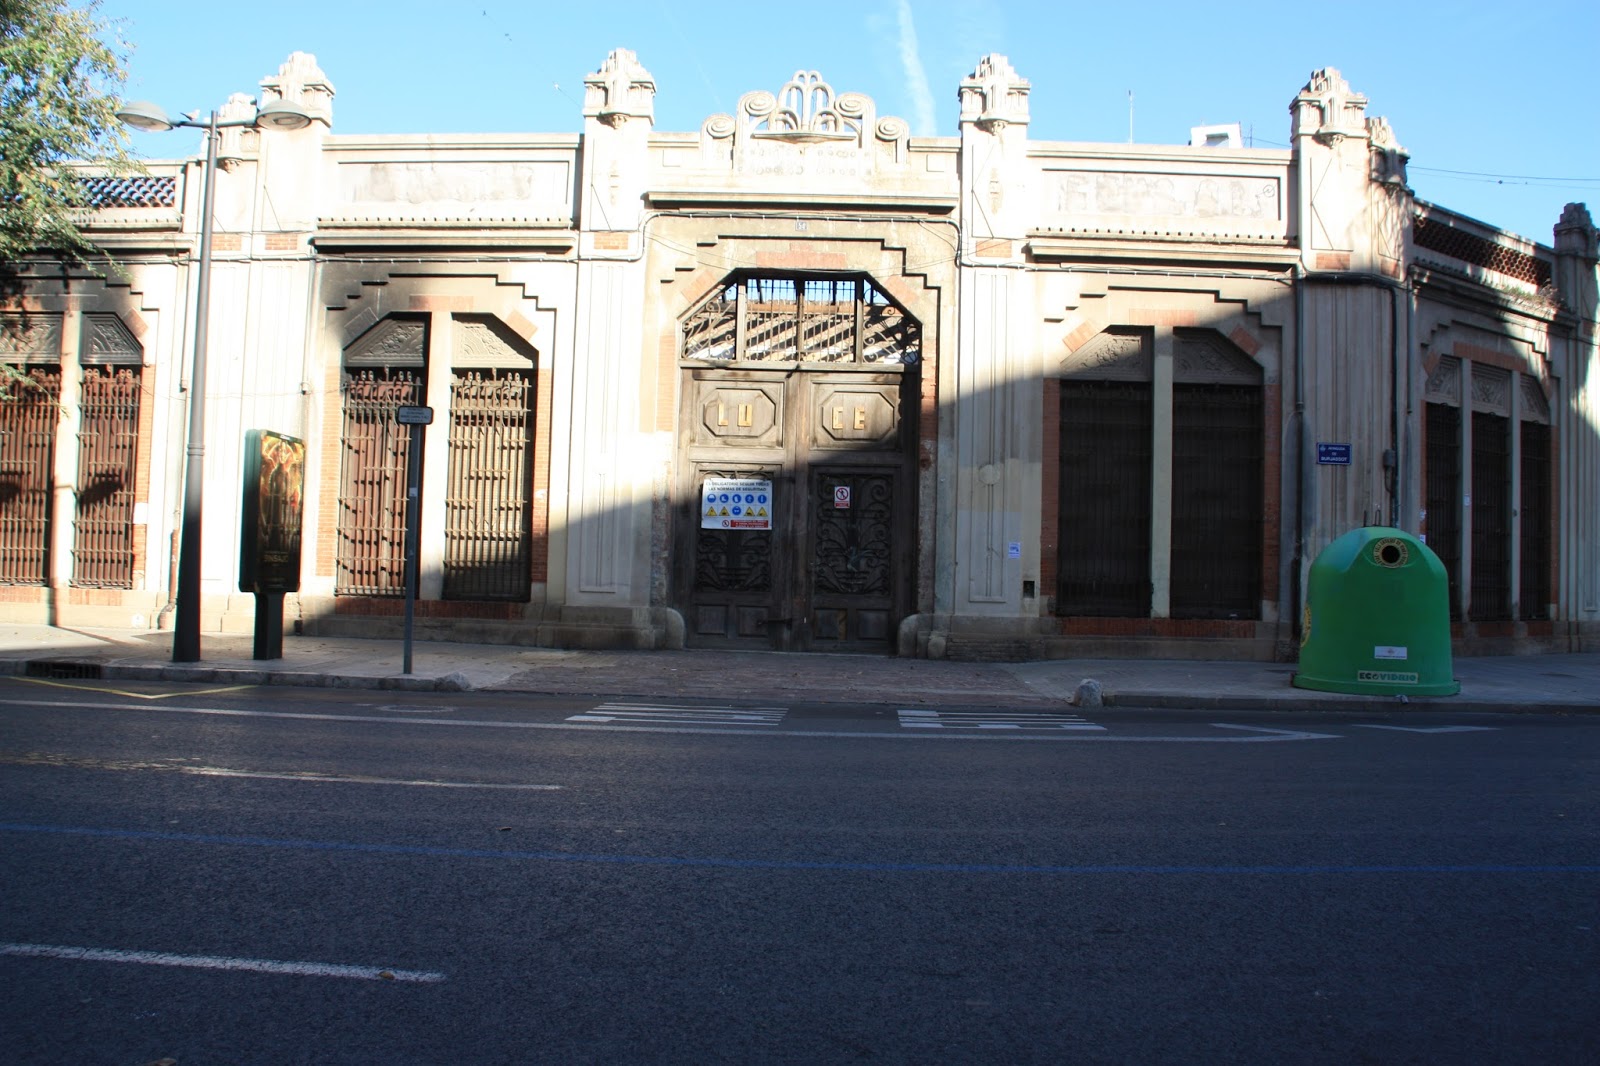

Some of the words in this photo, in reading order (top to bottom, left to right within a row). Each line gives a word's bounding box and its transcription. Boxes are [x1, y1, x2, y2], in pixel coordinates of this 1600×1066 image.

[717, 402, 753, 427] LU
[832, 406, 865, 430] CE
[1358, 672, 1416, 682] ECOVIDRIO
